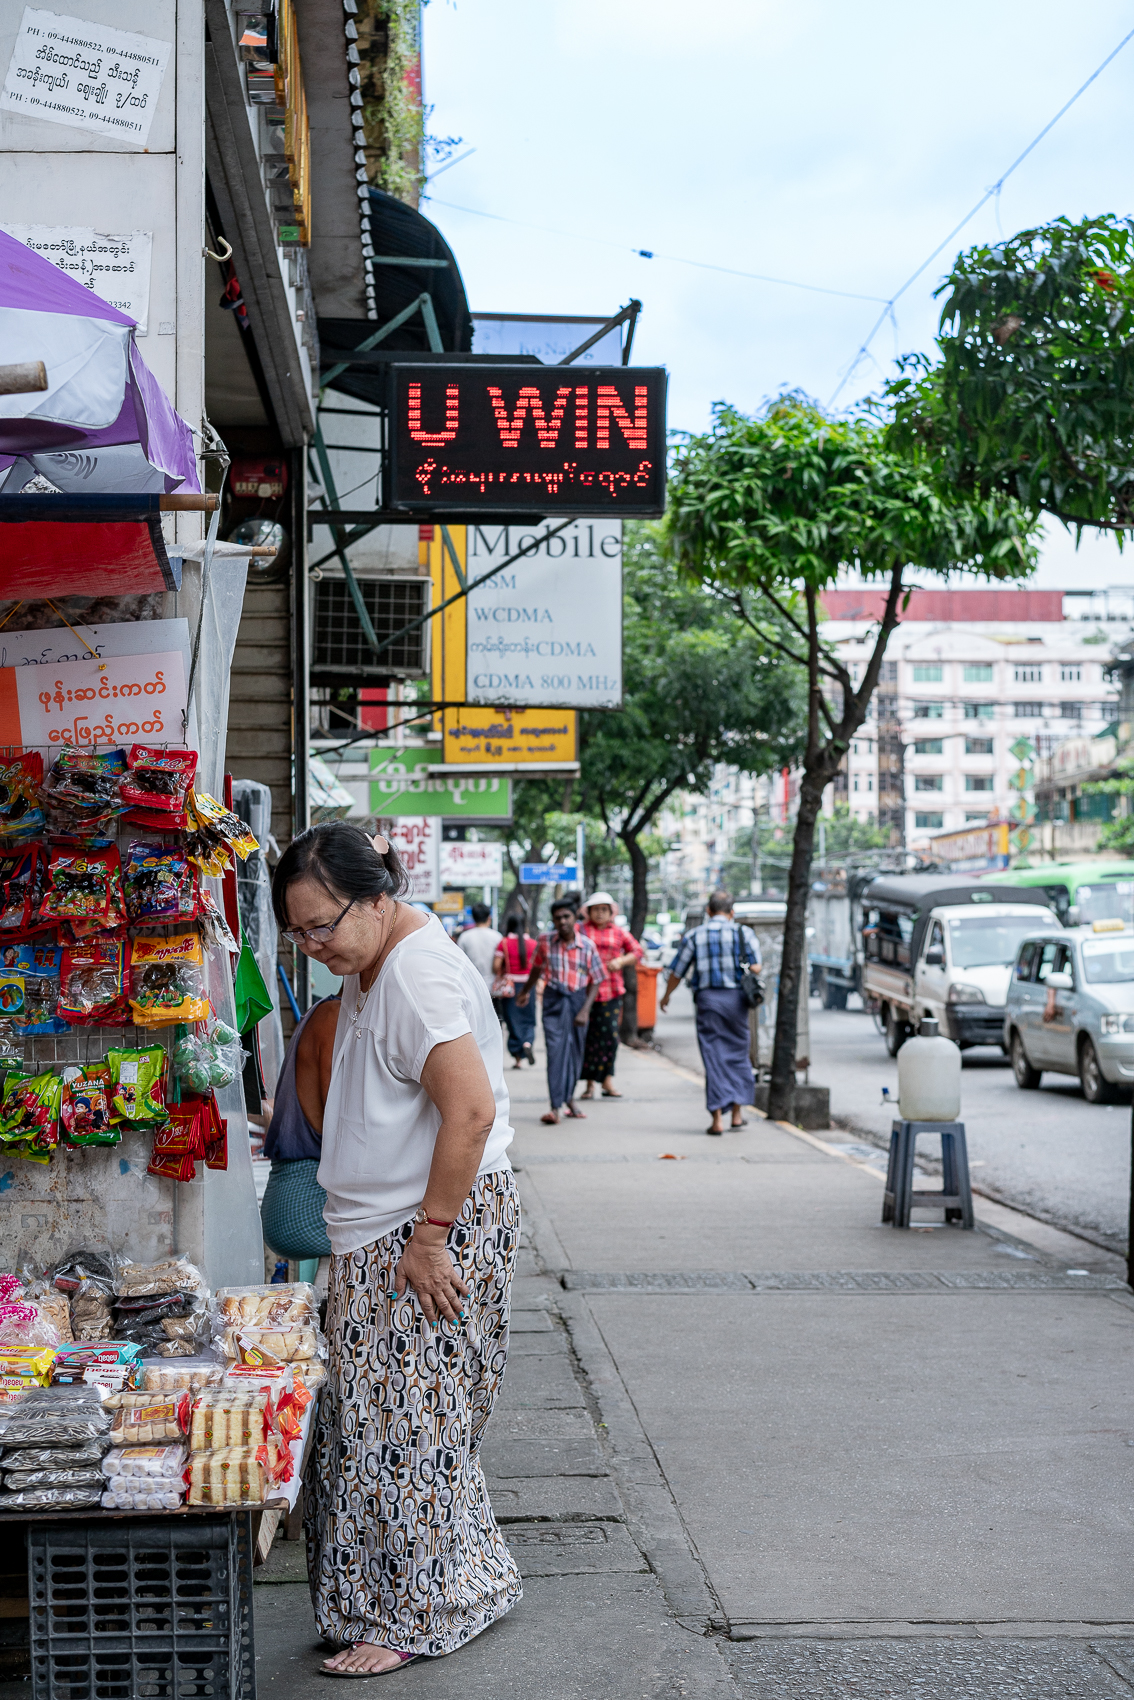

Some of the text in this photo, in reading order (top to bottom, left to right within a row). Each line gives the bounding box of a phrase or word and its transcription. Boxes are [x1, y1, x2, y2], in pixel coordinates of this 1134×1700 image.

[26, 26, 40, 37] PH
[106, 46, 160, 66] 09-444880511
[9, 91, 23, 102] PH
[88, 111, 143, 132] 09-444880511
[408, 382, 648, 449] U WIN
[469, 524, 623, 558] Mobile
[473, 573, 516, 590] GSM
[474, 607, 553, 623] WCDMA
[474, 673, 619, 691] CDMA 800 MHz
[72, 1079, 104, 1088] YUZANA
